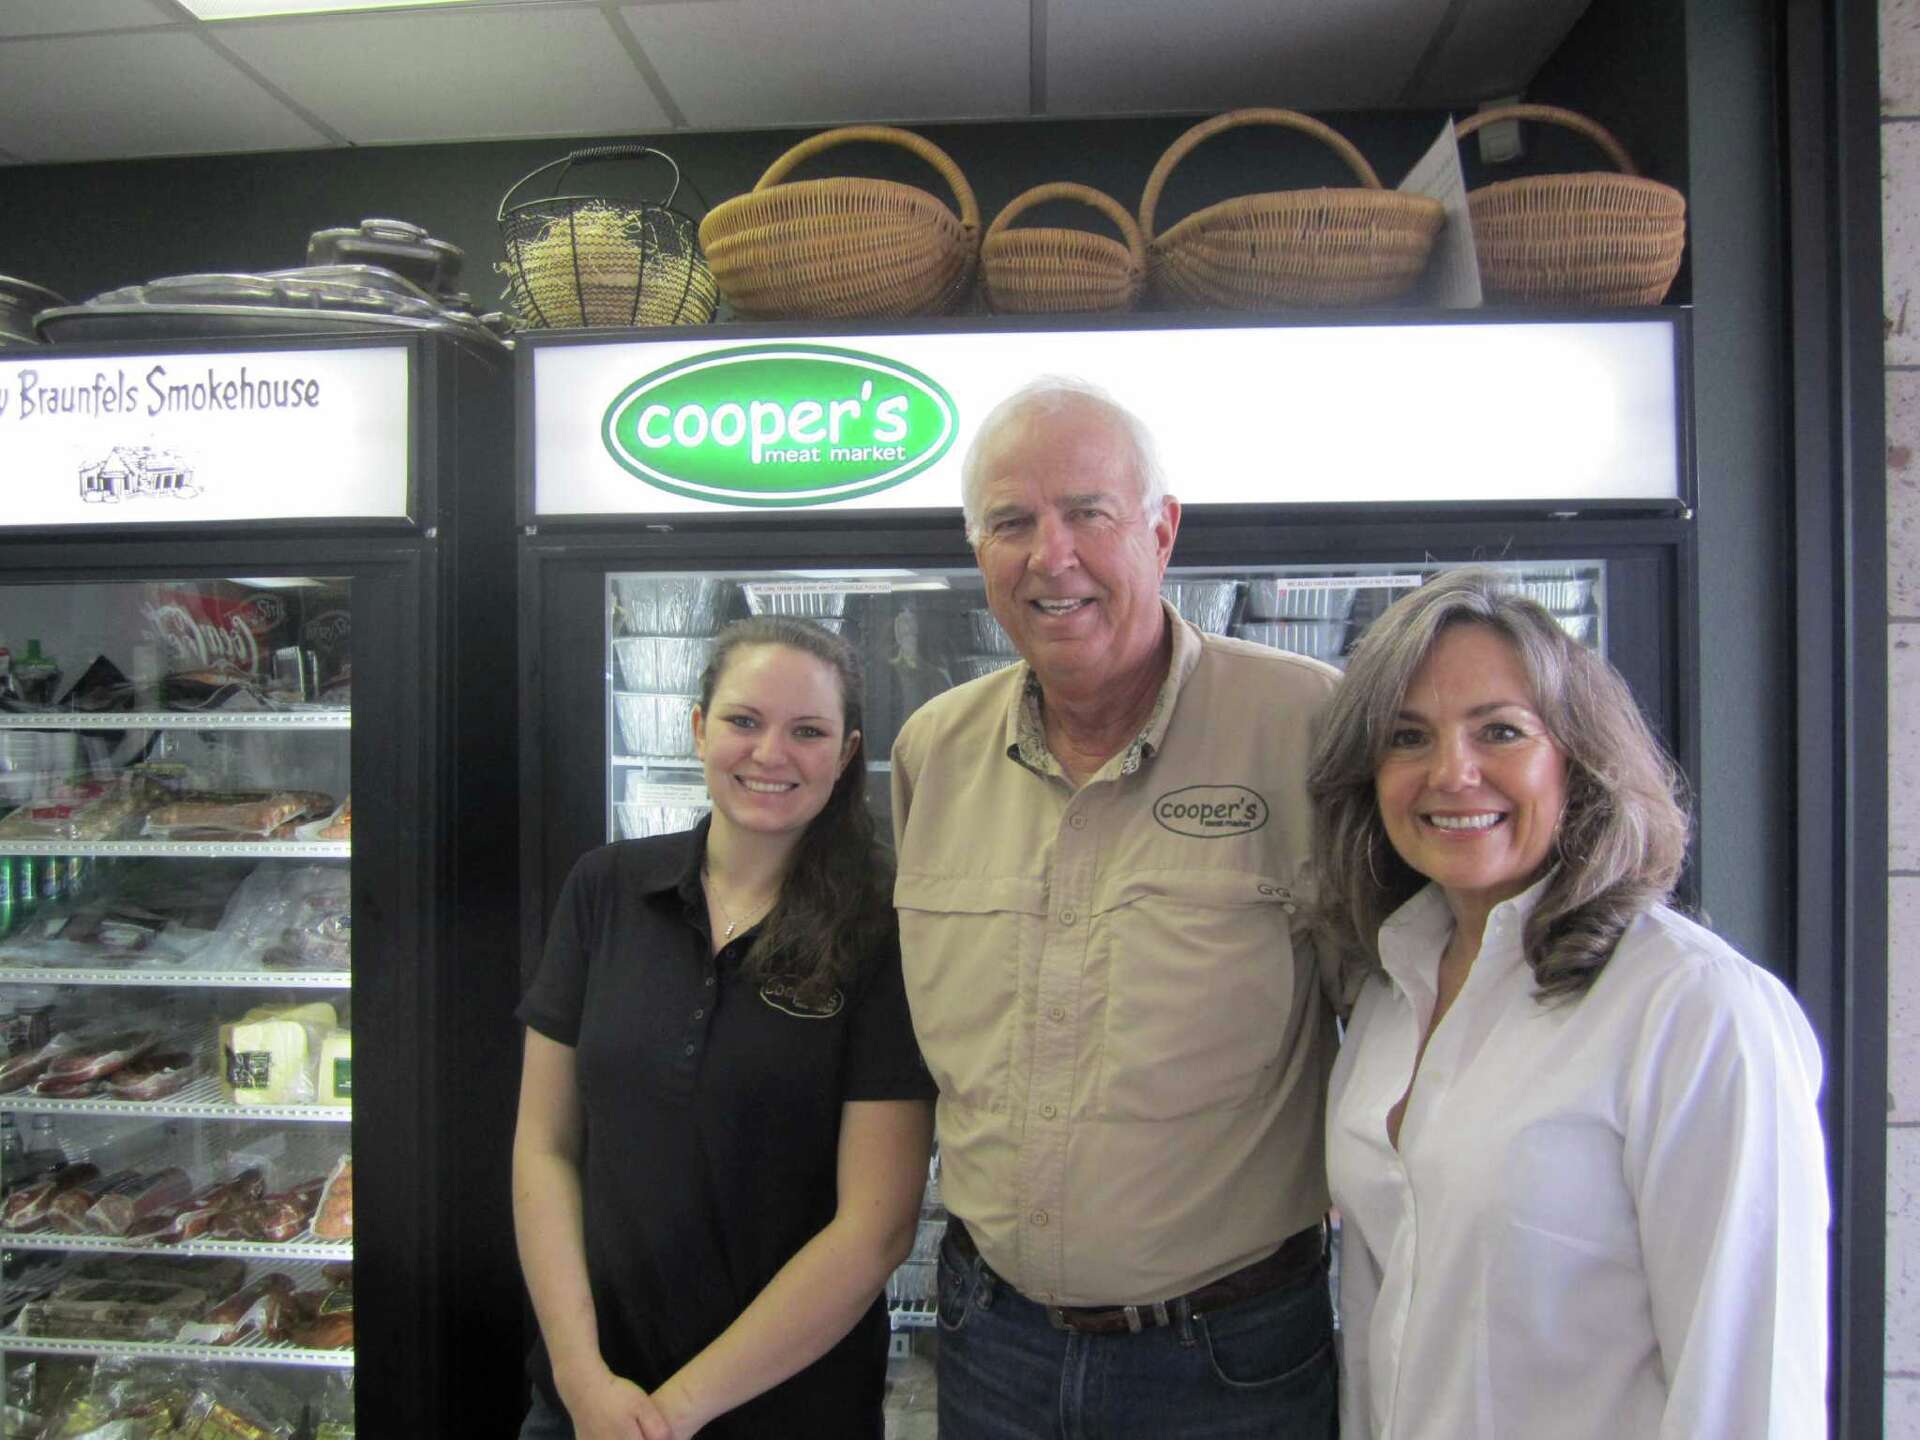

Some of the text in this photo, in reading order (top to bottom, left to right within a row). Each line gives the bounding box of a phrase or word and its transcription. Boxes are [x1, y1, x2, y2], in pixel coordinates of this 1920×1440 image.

[17, 368, 139, 420] Braunfels
[145, 365, 320, 417] Smokehouse
[637, 379, 908, 464] cooper's
[765, 444, 907, 462] meat market
[1160, 797, 1257, 826] cooper's
